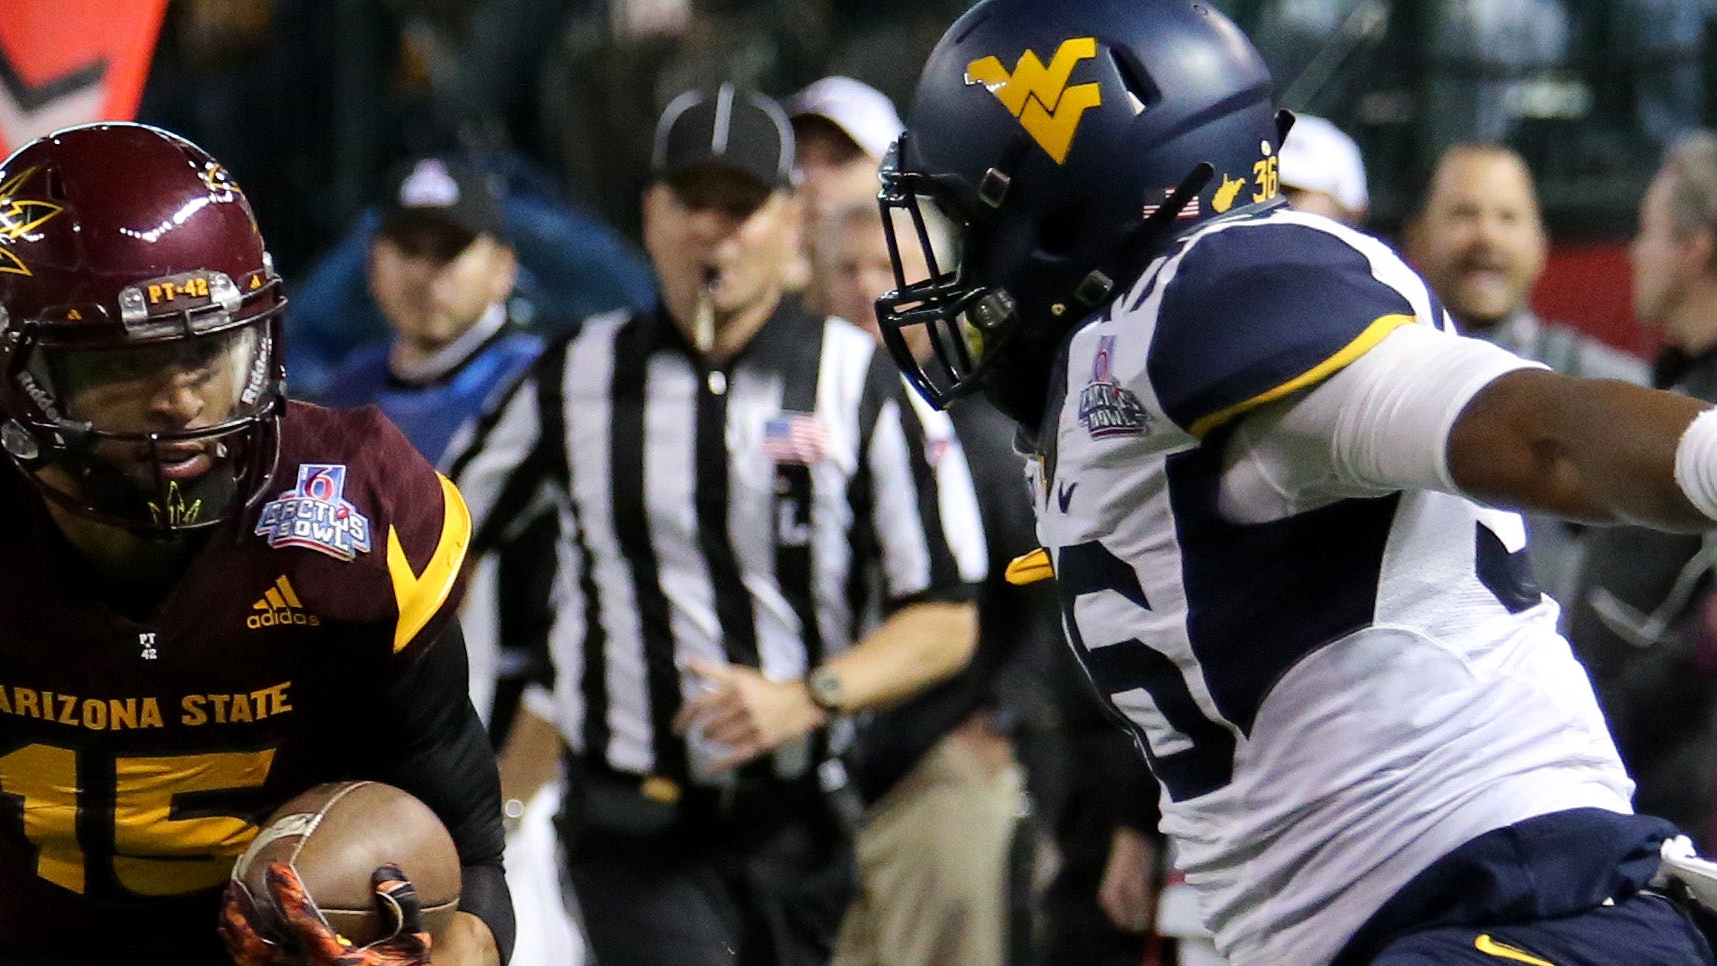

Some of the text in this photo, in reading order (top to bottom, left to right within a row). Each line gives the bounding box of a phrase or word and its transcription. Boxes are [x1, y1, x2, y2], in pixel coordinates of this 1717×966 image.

[1252, 156, 1278, 203] 36
[304, 467, 334, 501] 6
[247, 608, 320, 629] adidas
[139, 633, 156, 644] PT
[141, 649, 158, 660] 42
[181, 681, 292, 726] STATE
